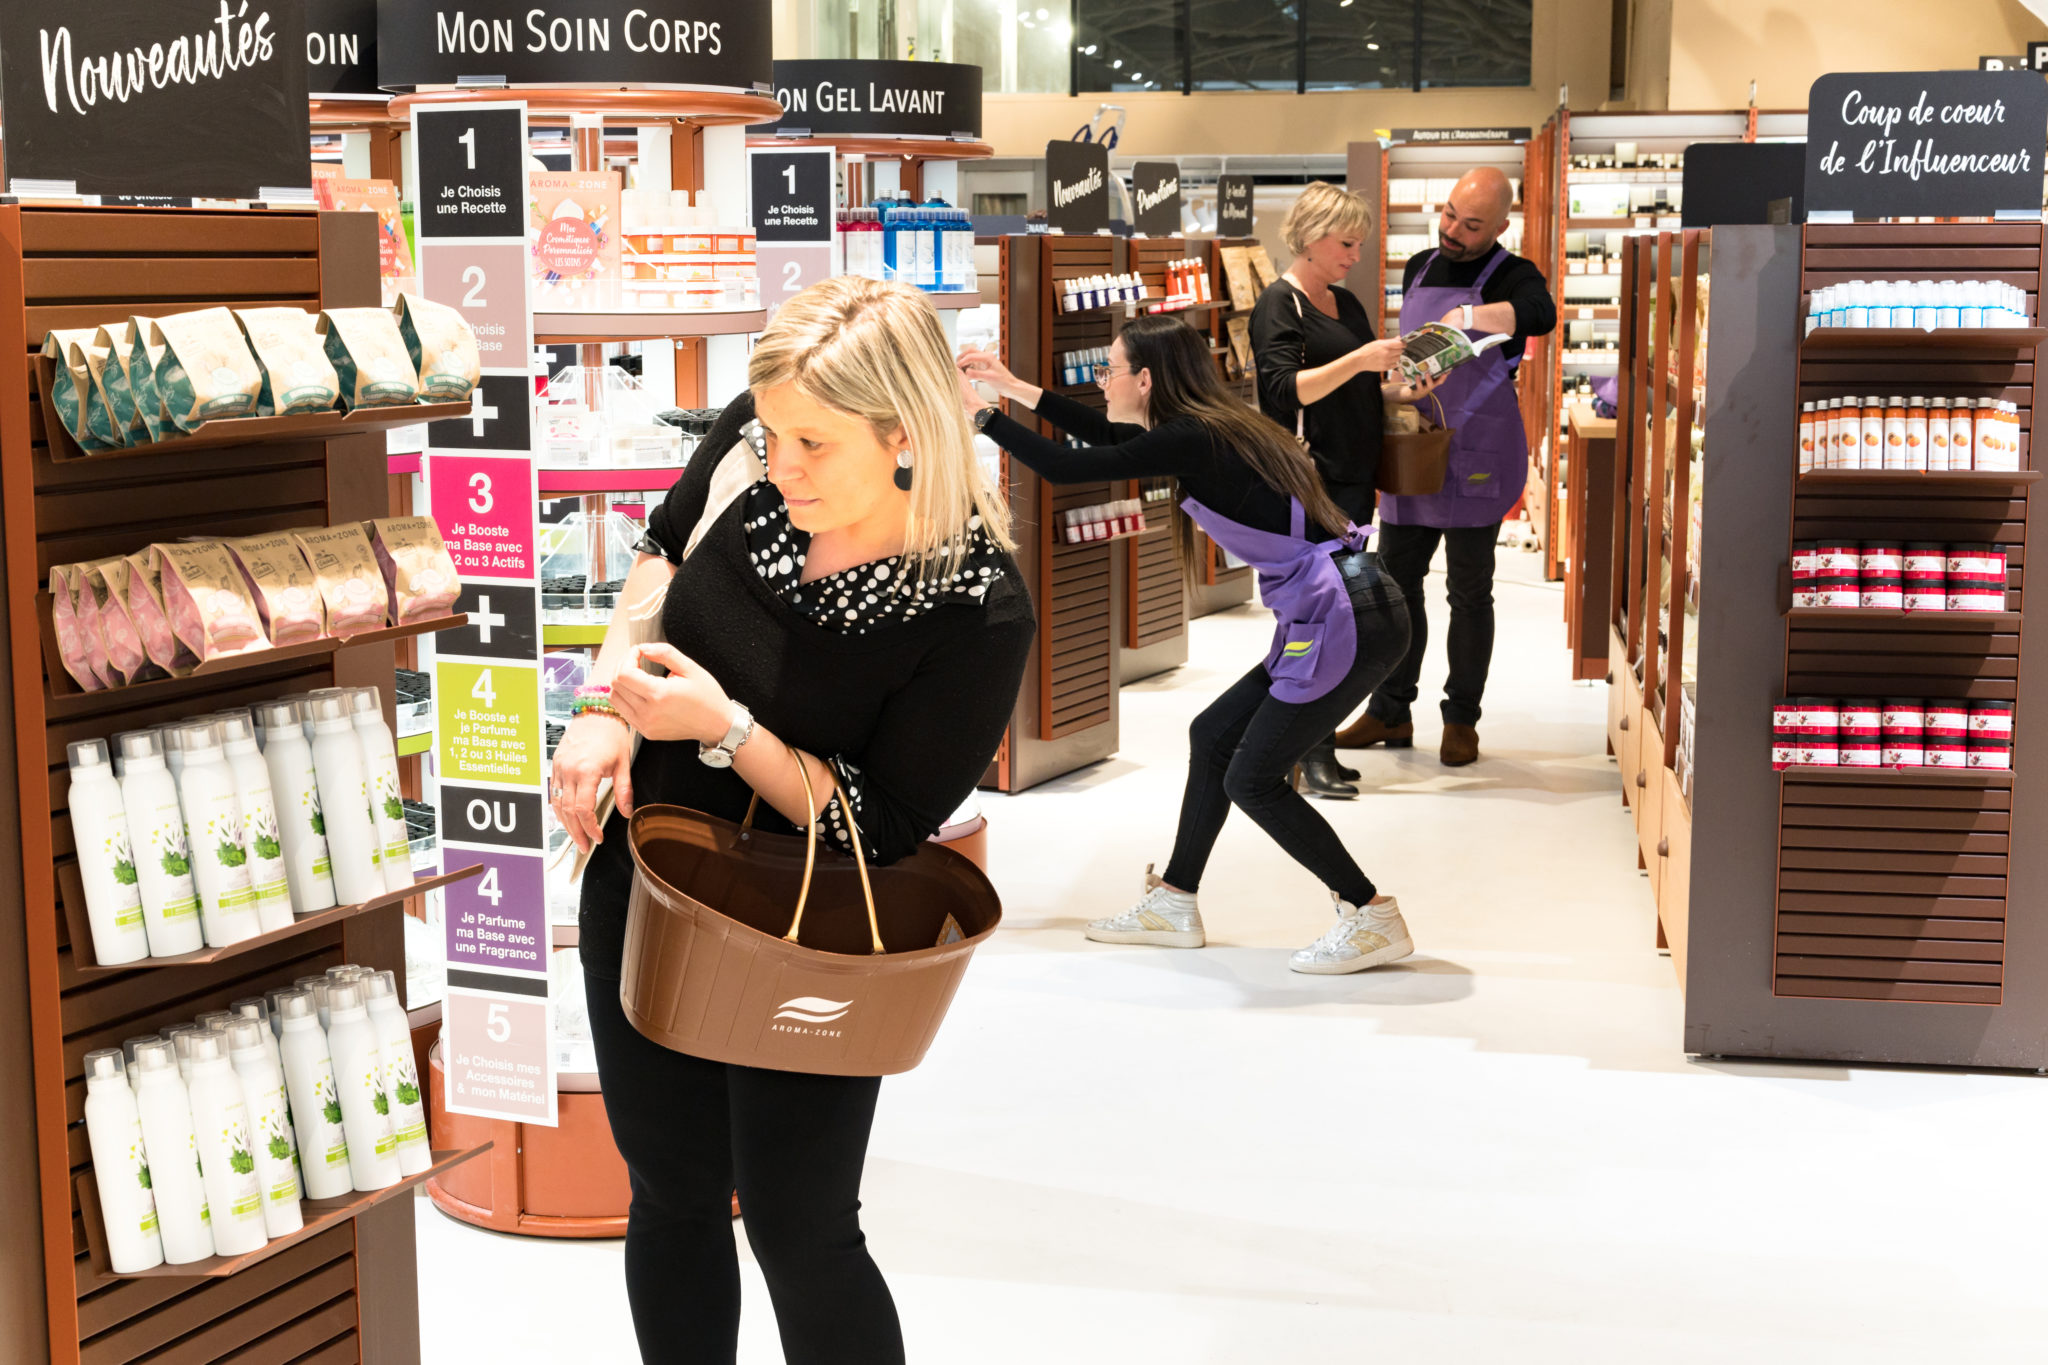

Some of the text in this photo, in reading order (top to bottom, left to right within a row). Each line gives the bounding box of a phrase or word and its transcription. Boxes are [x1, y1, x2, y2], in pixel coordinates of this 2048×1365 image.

[436, 8, 722, 56] MON SOIN CORPS
[39, 0, 276, 116] Nouveautés
[307, 31, 358, 66] OIN
[773, 81, 945, 115] ON GEL LAVANT
[1841, 89, 2006, 137] Coup de coeur
[458, 127, 477, 170] 1
[1819, 138, 2031, 182] de l'Influenceur
[782, 164, 796, 195] 1
[1053, 167, 1103, 208] Nouveautés
[441, 185, 502, 199] Je Choisis
[437, 200, 507, 215] une Recette
[768, 205, 815, 215] Je Choisis
[764, 216, 818, 226] une Recette
[462, 265, 487, 308] 2
[782, 261, 802, 291] 2
[473, 323, 506, 336] hoisis
[468, 472, 494, 514] 3
[452, 523, 509, 537] Je Booste
[444, 538, 523, 554] ma Base avec
[454, 554, 526, 569] 2 ou 3 Actifs
[471, 669, 497, 708] 4
[454, 709, 520, 724] Je Booste et
[460, 722, 517, 737] je Parfume
[453, 736, 526, 751] ma Base avec
[450, 747, 528, 764] 1, 2 ou 3 Huiles
[459, 760, 522, 776] Essentielles
[466, 798, 517, 833] OU
[477, 867, 503, 906] 4
[461, 911, 526, 929] Je Parfume
[456, 927, 535, 945] ma Base avec
[455, 943, 537, 961] une Fragrance
[486, 1004, 511, 1043] 5
[456, 1054, 541, 1075] Je Choisis mes
[466, 1069, 535, 1089] Accessoires
[457, 1082, 545, 1105] & mon Matériel
